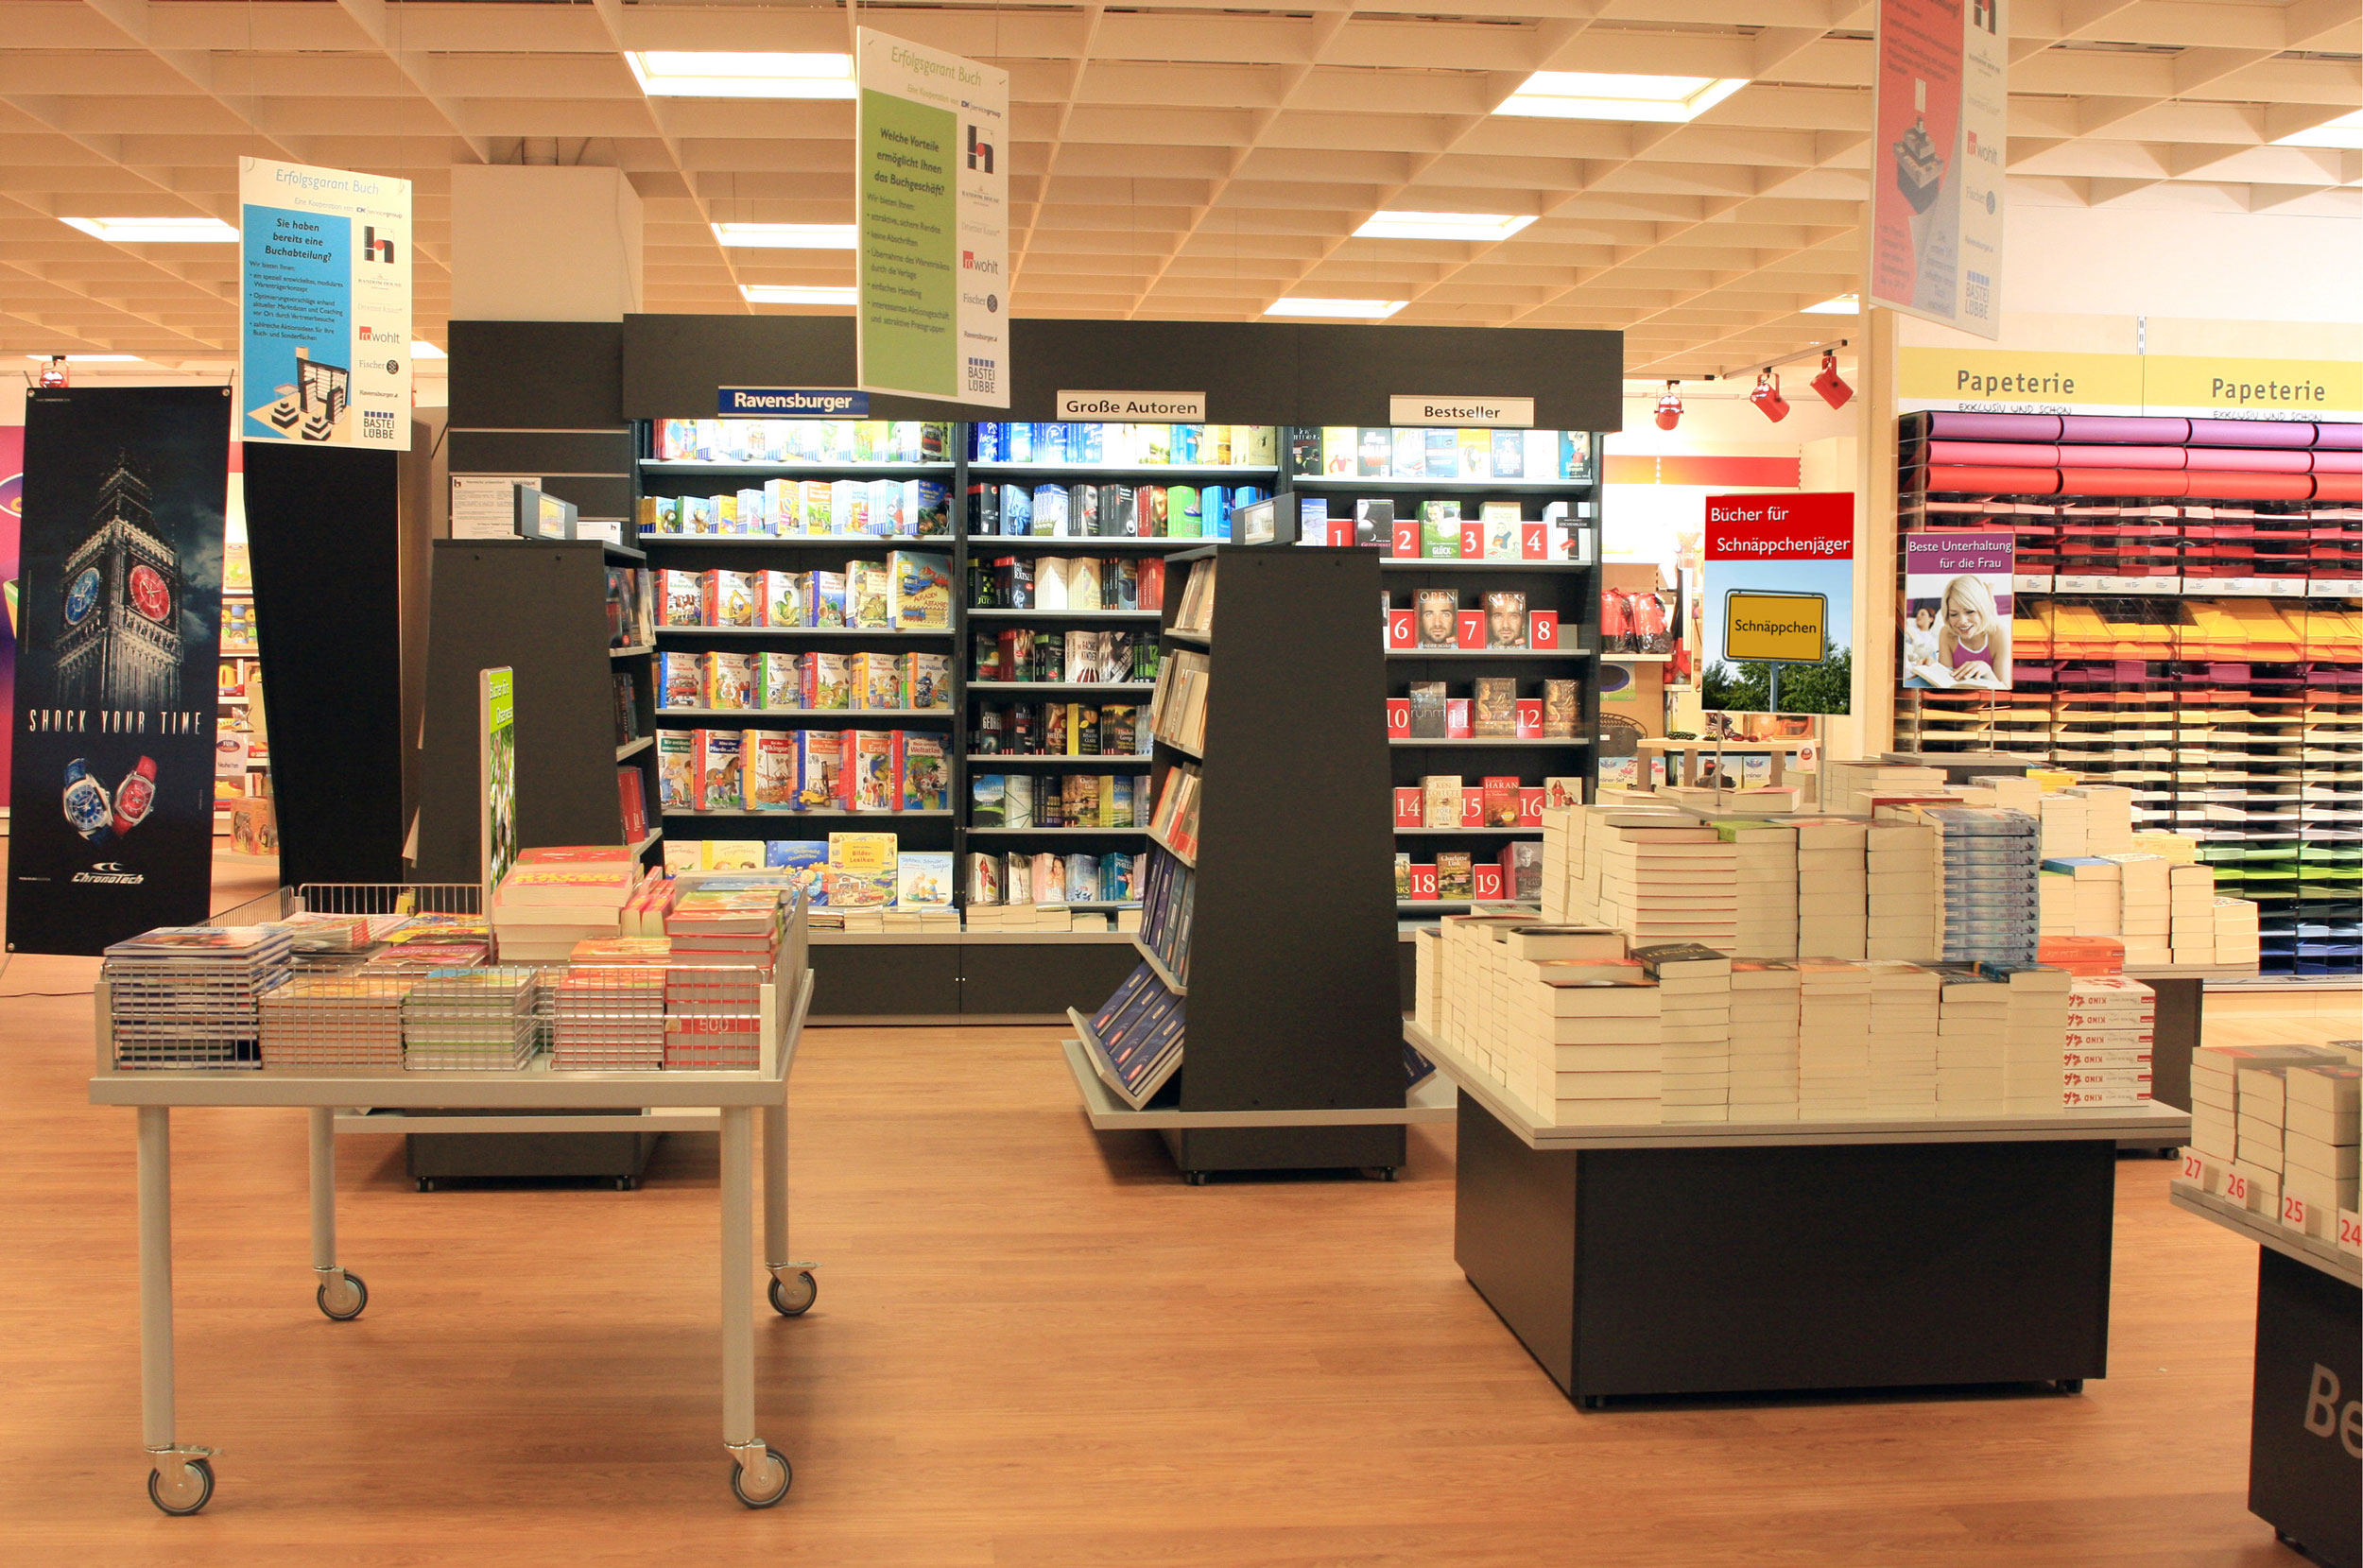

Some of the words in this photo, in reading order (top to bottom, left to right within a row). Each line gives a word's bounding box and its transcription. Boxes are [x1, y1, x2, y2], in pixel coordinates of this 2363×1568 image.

[891, 45, 956, 79] Erfolgsgarant
[958, 66, 982, 87] Buch
[880, 127, 909, 146] Welche
[910, 135, 940, 153] Vorteile
[876, 151, 919, 169] ermöglicht
[920, 159, 942, 175] Ihnen
[276, 168, 349, 190] Erfolgsgarant
[353, 179, 379, 195] Buch
[874, 170, 888, 183] das
[890, 174, 945, 198] Buchgeschäft?
[277, 217, 290, 228] Sie
[293, 219, 319, 233] haben
[273, 233, 302, 245] bereits
[304, 237, 323, 247] eine
[265, 245, 332, 264] Buchabteilung?
[963, 256, 999, 275] rowohlt
[963, 293, 986, 306] Fischer
[359, 331, 401, 344] rowohlt
[359, 360, 385, 370] Fischer
[968, 366, 995, 382] BASTEI
[968, 379, 995, 394] LÜBBE
[1957, 370, 2075, 397] Papeterie
[2212, 377, 2325, 405] Papeterie
[734, 391, 853, 413] Ravensburger
[1066, 400, 1120, 413] Große
[1126, 401, 1198, 414] Autoren
[2010, 405, 2034, 415] UND
[1423, 405, 1501, 420] Bestseller
[2264, 410, 2285, 422] UND
[363, 418, 395, 430] BASTEI
[363, 428, 395, 440] LÜBBE
[1711, 507, 1763, 523] Bücher
[1767, 505, 1789, 521] für
[1334, 529, 1342, 546] 1
[1398, 529, 1412, 550] 2
[1464, 530, 1477, 553] 3
[1526, 529, 1542, 552] 4
[1716, 537, 1852, 557] Schnäppchenjäger
[1432, 544, 1453, 556] GLÜCK
[1908, 540, 1939, 553] Beste
[1941, 540, 2013, 556] Unterhaltung
[1940, 557, 1963, 570] für
[1965, 558, 1975, 569] die
[1978, 558, 2003, 570] Frau
[1420, 591, 1457, 602] OPEN
[1394, 617, 1408, 641] 6
[1464, 620, 1477, 641] 7
[1537, 620, 1551, 641] 8
[1734, 618, 1818, 636] Schnäppchen
[28, 709, 87, 733] SHOCK
[101, 710, 146, 734] YOUR
[161, 711, 201, 735] TIME
[1387, 708, 1408, 729] 10
[1450, 709, 1471, 729] 11
[1517, 709, 1541, 729] 12
[868, 744, 887, 753] Erde
[910, 746, 941, 754] Weltatlas
[1397, 796, 1421, 818] 14
[1460, 796, 1482, 818] 15
[1520, 795, 1544, 818] 16
[1440, 854, 1468, 863] Charlotte
[71, 871, 145, 885] ChronoTech
[1412, 873, 1436, 893] 18
[1476, 873, 1500, 896] 19
[699, 1018, 730, 1032] 500
[2084, 1075, 2103, 1083] KIND
[2184, 1156, 2202, 1180] 27
[2227, 1173, 2246, 1199] 26
[2284, 1196, 2303, 1223] 25
[2340, 1218, 2362, 1248] 24
[2304, 1361, 2362, 1459] Be
